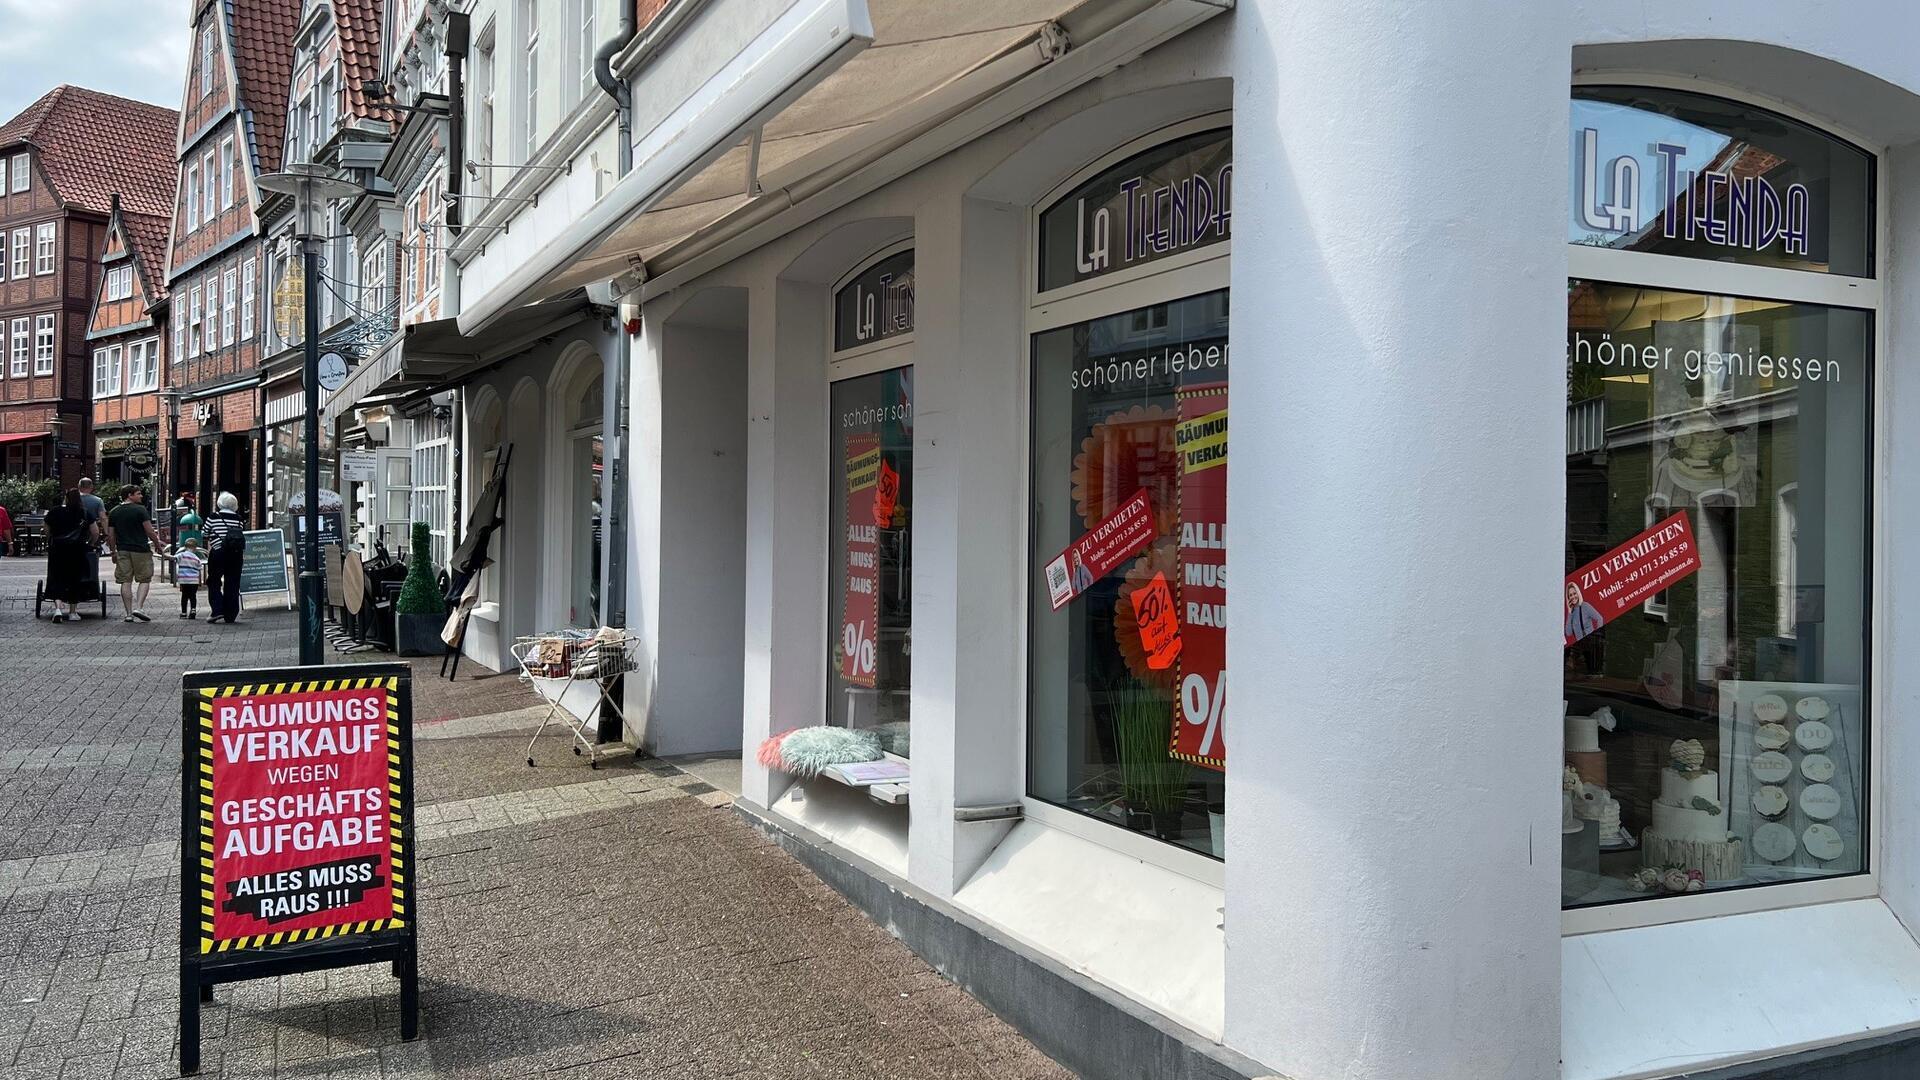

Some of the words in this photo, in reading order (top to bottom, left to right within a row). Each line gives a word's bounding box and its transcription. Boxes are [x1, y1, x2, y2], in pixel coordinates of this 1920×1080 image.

[1583, 128, 1640, 234] LA
[1656, 142, 1809, 256] TIENDA
[1076, 198, 1110, 274] LA
[856, 284, 875, 340] LA
[1071, 355, 1157, 390] schöner
[1567, 331, 1673, 370] höner
[1684, 344, 1840, 382] geniessen
[843, 405, 888, 427] schöner
[850, 470, 877, 488] VERKAUF
[848, 525, 876, 543] ALLES
[1080, 537, 1092, 555] ZU
[1092, 495, 1145, 543] VERMIETEN
[1115, 533, 1123, 544] 171
[1123, 529, 1128, 538] 3
[850, 551, 874, 568] MUSS
[1581, 567, 1601, 590] ZU
[1602, 520, 1685, 576] VERMIETEN
[1598, 581, 1624, 600] Mobil:
[1625, 571, 1639, 584] +49
[1639, 563, 1652, 577] 171
[1653, 559, 1659, 569] 3
[1659, 553, 1669, 565] 26
[1669, 546, 1678, 559] 85
[1678, 541, 1688, 553] 59
[850, 577, 872, 594] RAUS
[1137, 586, 1168, 629] 50%
[1187, 602, 1227, 629] RAU
[220, 697, 380, 730] RÄUMUNGS
[221, 724, 380, 763] VERKAUF
[267, 764, 339, 785] WEGEN
[221, 787, 382, 825] GESCHÄFTS
[222, 815, 383, 859] AUFGABE
[236, 871, 302, 896] ALLES
[309, 862, 372, 888] MUSS
[260, 894, 320, 917] RAUS
[327, 889, 350, 909] !!!
